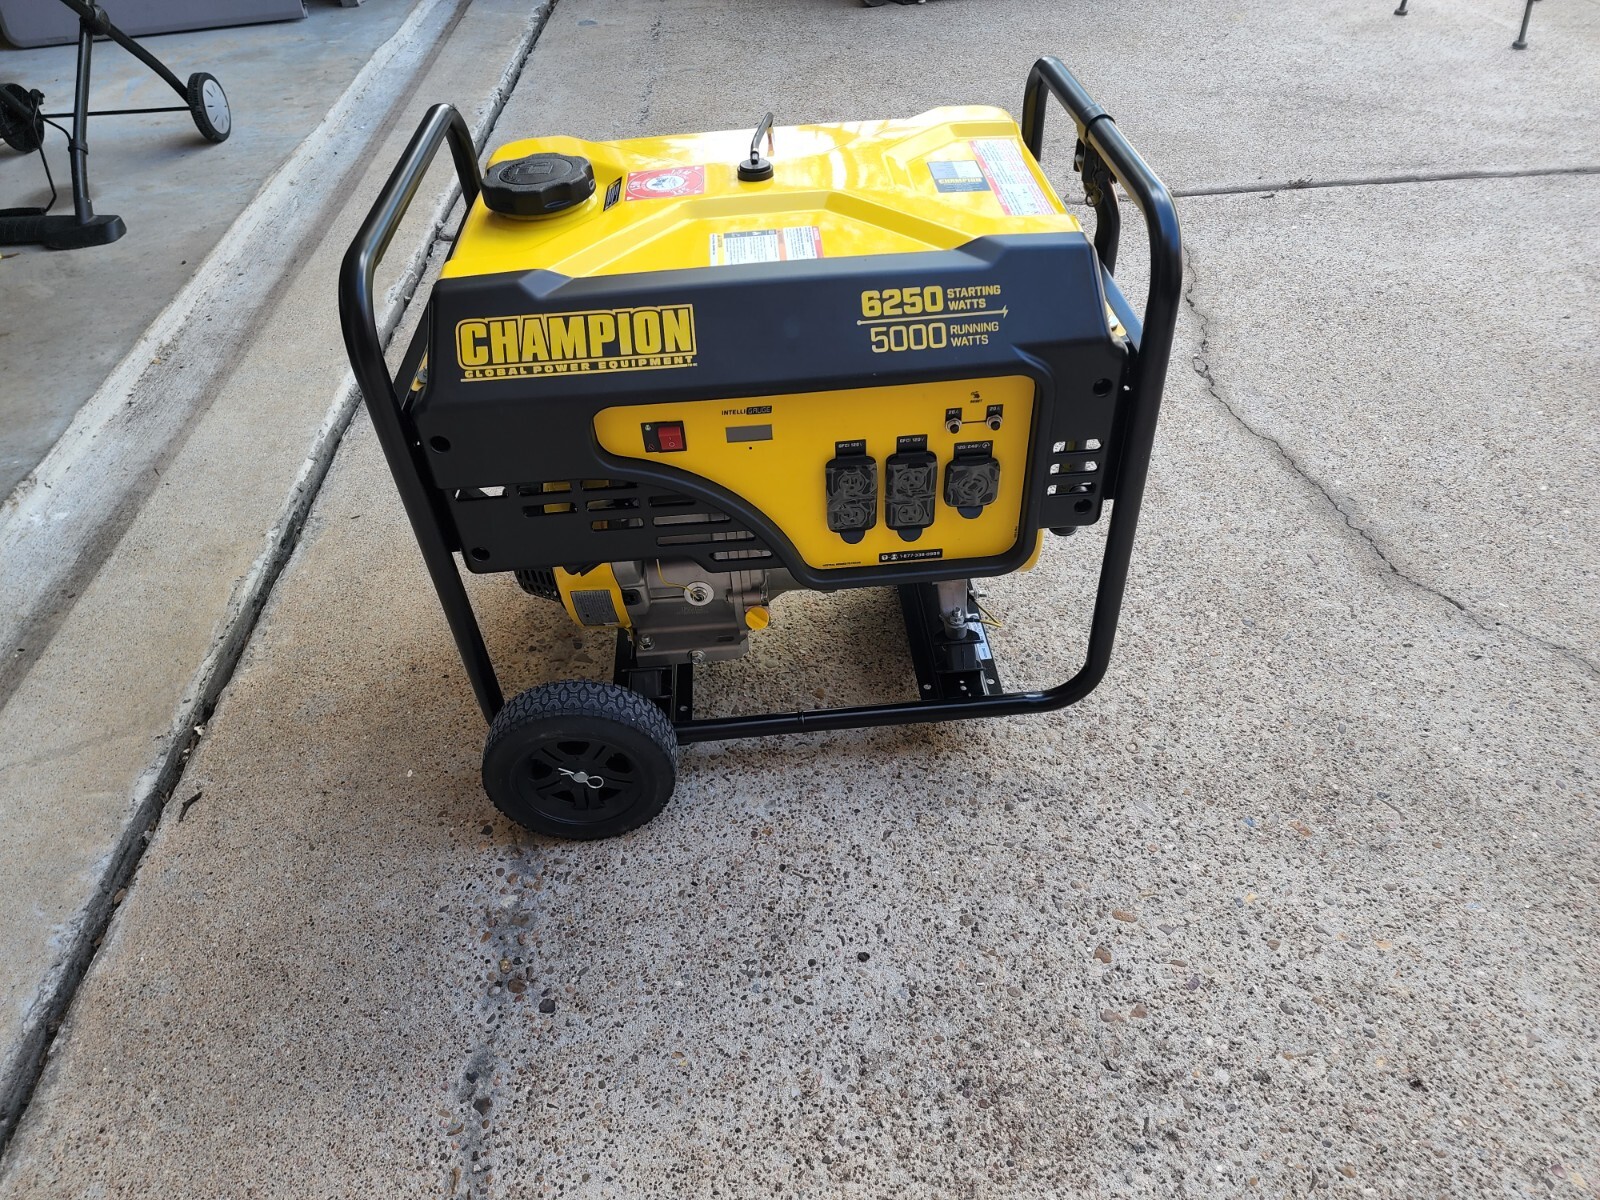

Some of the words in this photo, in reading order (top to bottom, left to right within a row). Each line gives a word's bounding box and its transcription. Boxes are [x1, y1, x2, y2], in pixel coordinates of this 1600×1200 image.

[861, 285, 944, 317] 6250
[947, 284, 1001, 298] STARTING
[947, 298, 986, 310] WATTS
[459, 308, 694, 367] CHAMPION
[870, 322, 947, 353] 5000
[950, 321, 999, 335] RUNNING
[950, 335, 989, 347] WATTS
[464, 367, 527, 378] GLOBAL
[533, 361, 591, 374] POWER
[598, 355, 694, 369] EQUIPMENT
